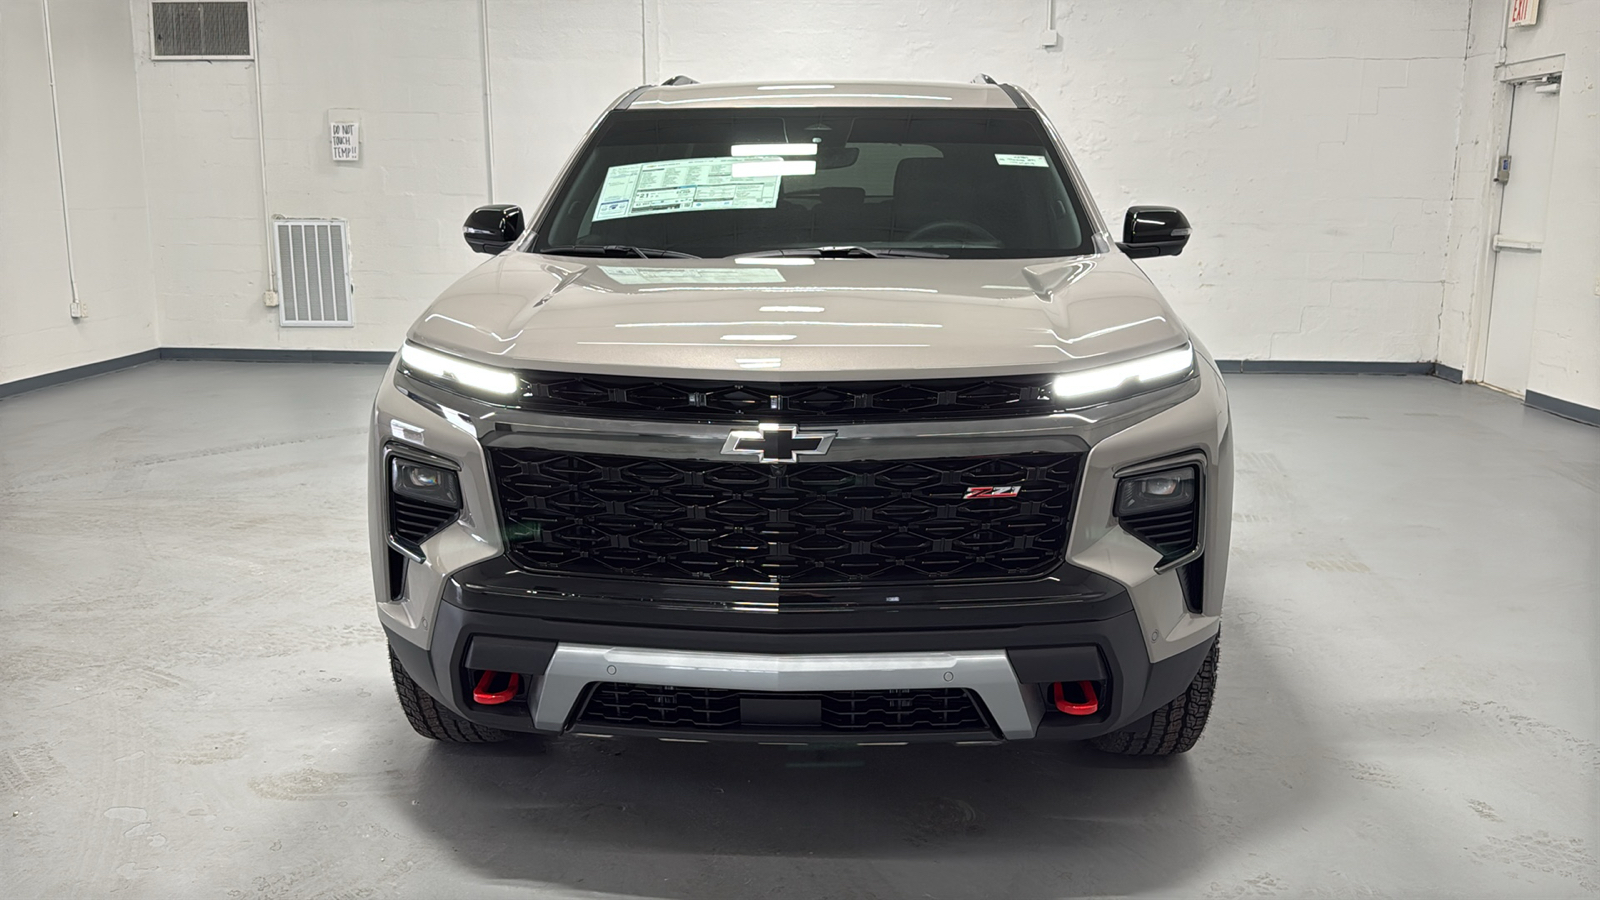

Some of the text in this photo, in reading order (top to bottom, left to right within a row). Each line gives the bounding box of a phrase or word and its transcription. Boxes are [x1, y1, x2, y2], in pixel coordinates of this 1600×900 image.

[1512, 0, 1528, 22] EXIT
[332, 124, 354, 135] DO NOT
[332, 136, 350, 146] TOUCH
[333, 146, 357, 158] TEMP!!
[963, 486, 1021, 499] Z71
